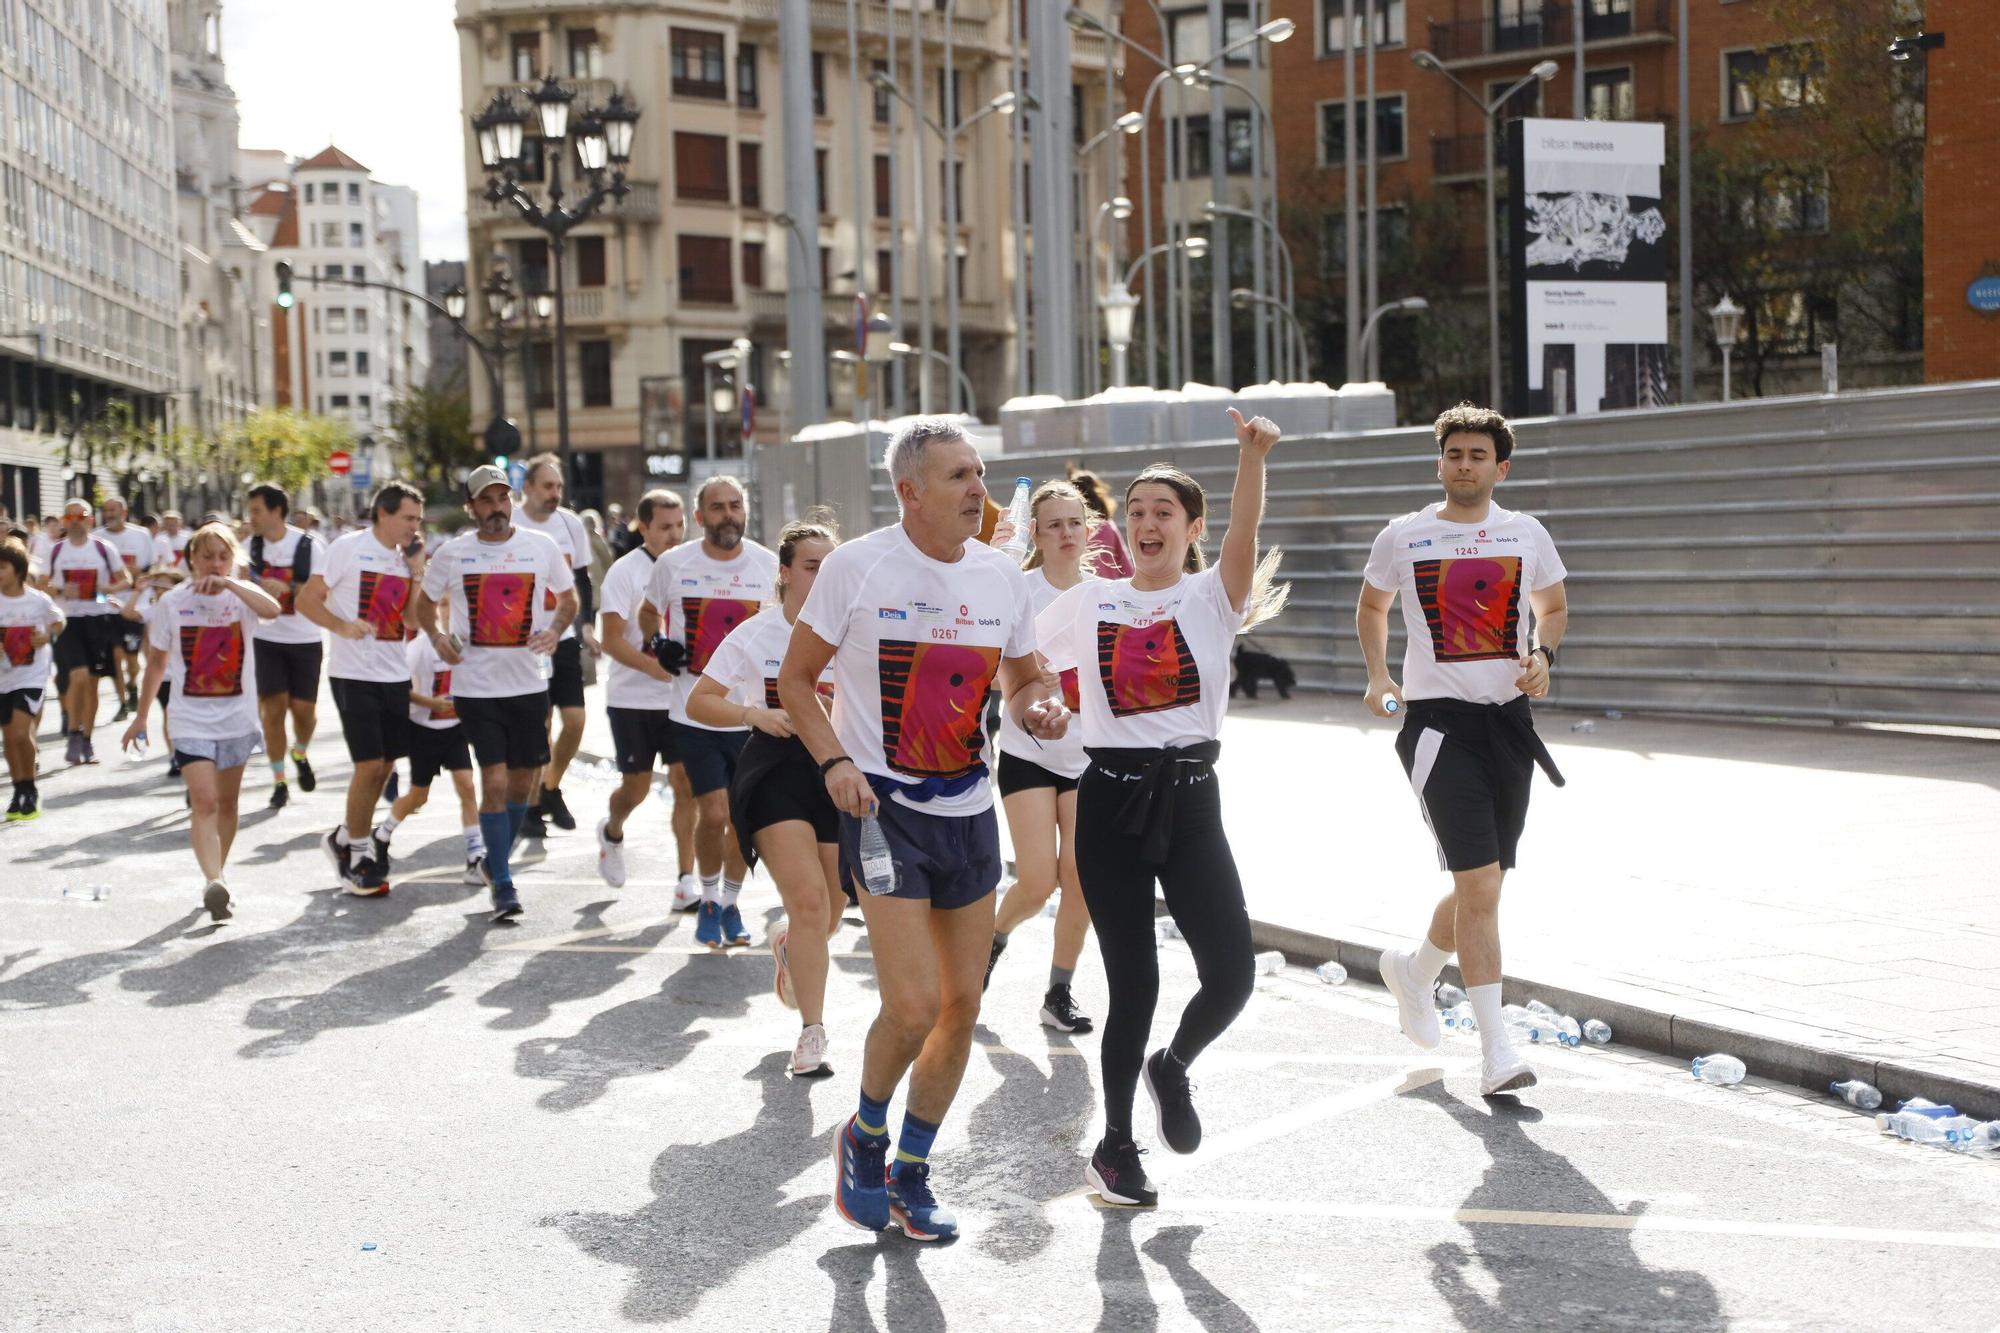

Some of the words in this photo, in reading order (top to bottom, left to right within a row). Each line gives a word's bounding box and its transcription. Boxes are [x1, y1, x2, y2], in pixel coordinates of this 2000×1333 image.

[1455, 547, 1479, 556] 1243
[882, 610, 902, 619] Deia
[955, 618, 975, 626] Bilbao
[932, 628, 958, 640] 0267
